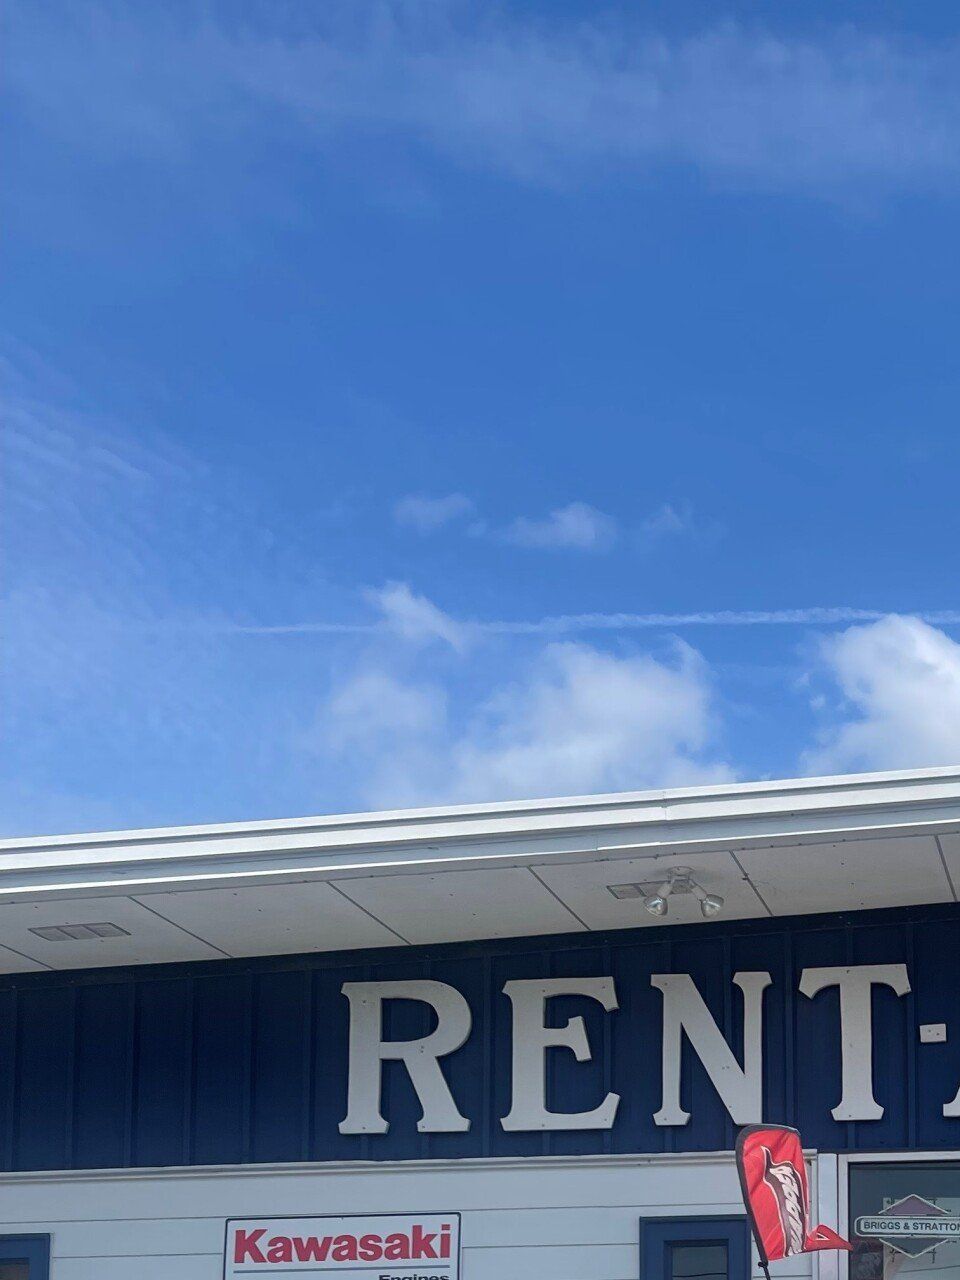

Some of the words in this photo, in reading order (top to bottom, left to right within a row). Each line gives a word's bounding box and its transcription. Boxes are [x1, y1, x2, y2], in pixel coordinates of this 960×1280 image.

[863, 1221, 901, 1231] BRIGGS
[903, 1222, 912, 1231] &
[234, 1224, 451, 1264] Kawasaki
